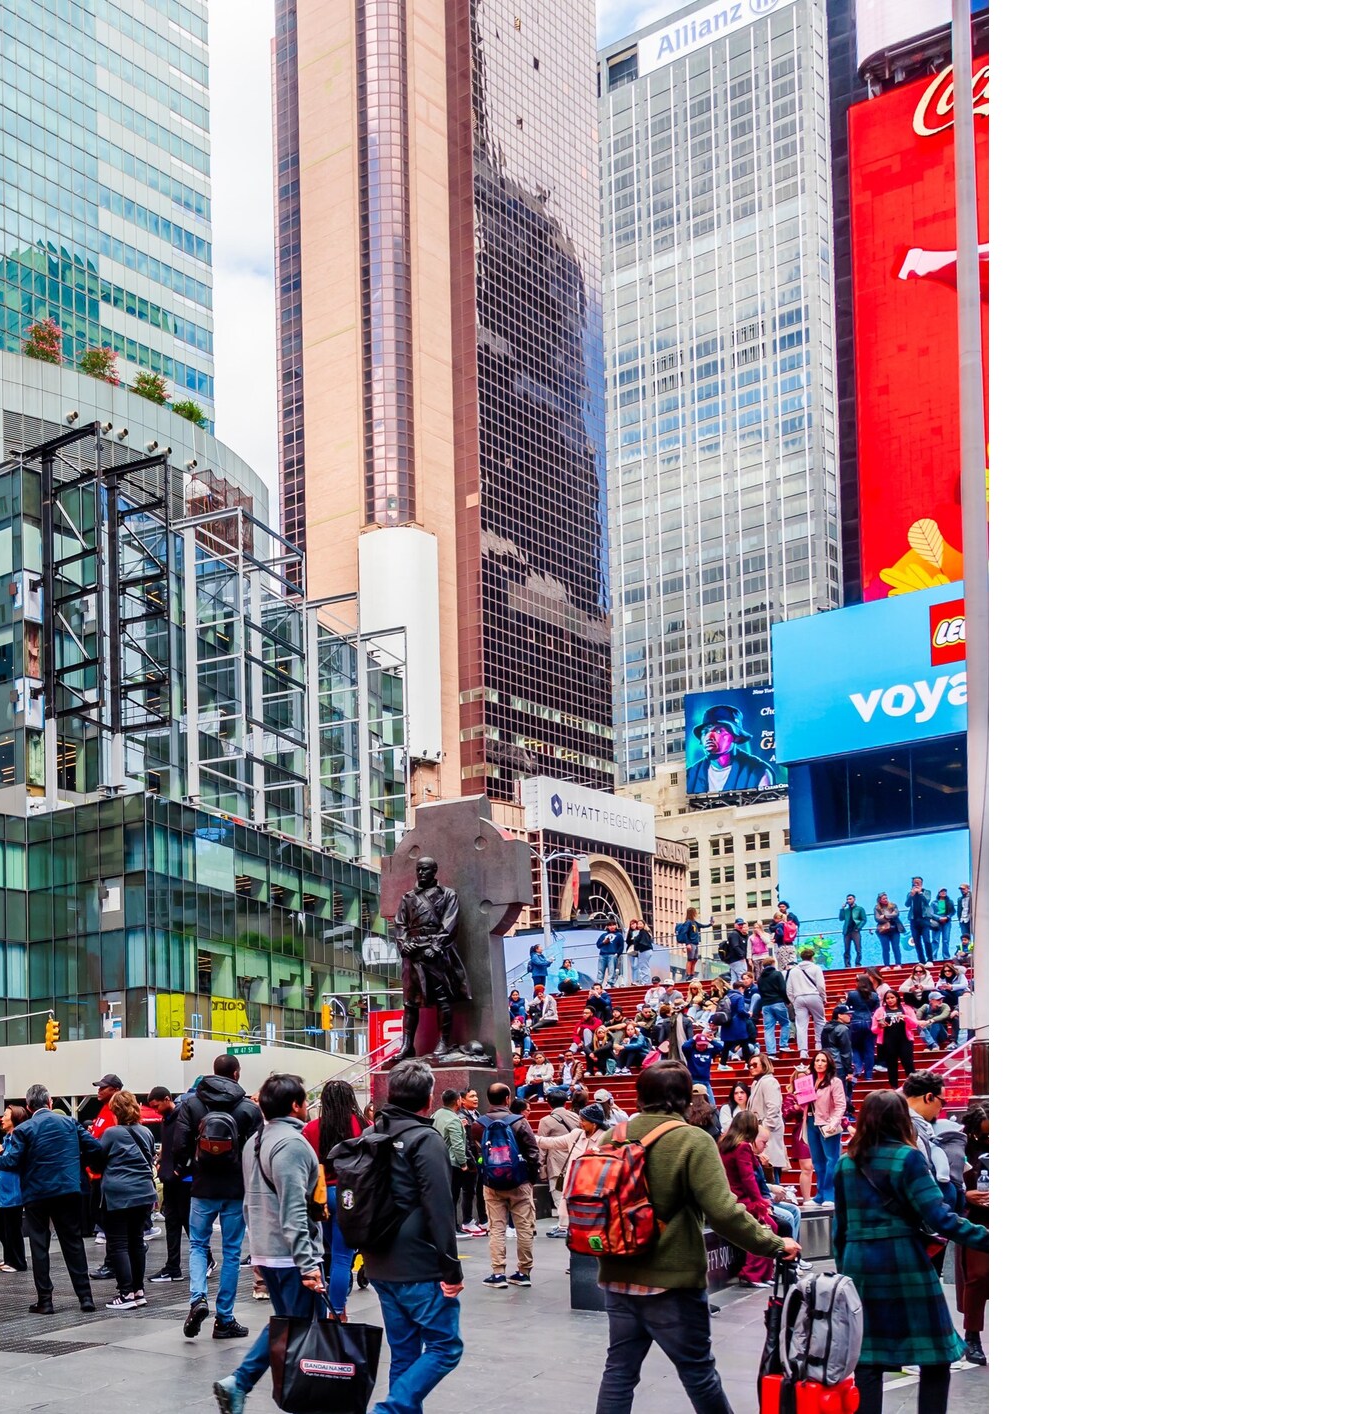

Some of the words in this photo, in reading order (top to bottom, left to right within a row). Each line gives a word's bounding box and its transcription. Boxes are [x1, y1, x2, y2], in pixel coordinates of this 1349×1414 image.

[656, 2, 742, 60] Allianz
[566, 801, 600, 822] HYATT
[603, 810, 648, 833] REGENCY
